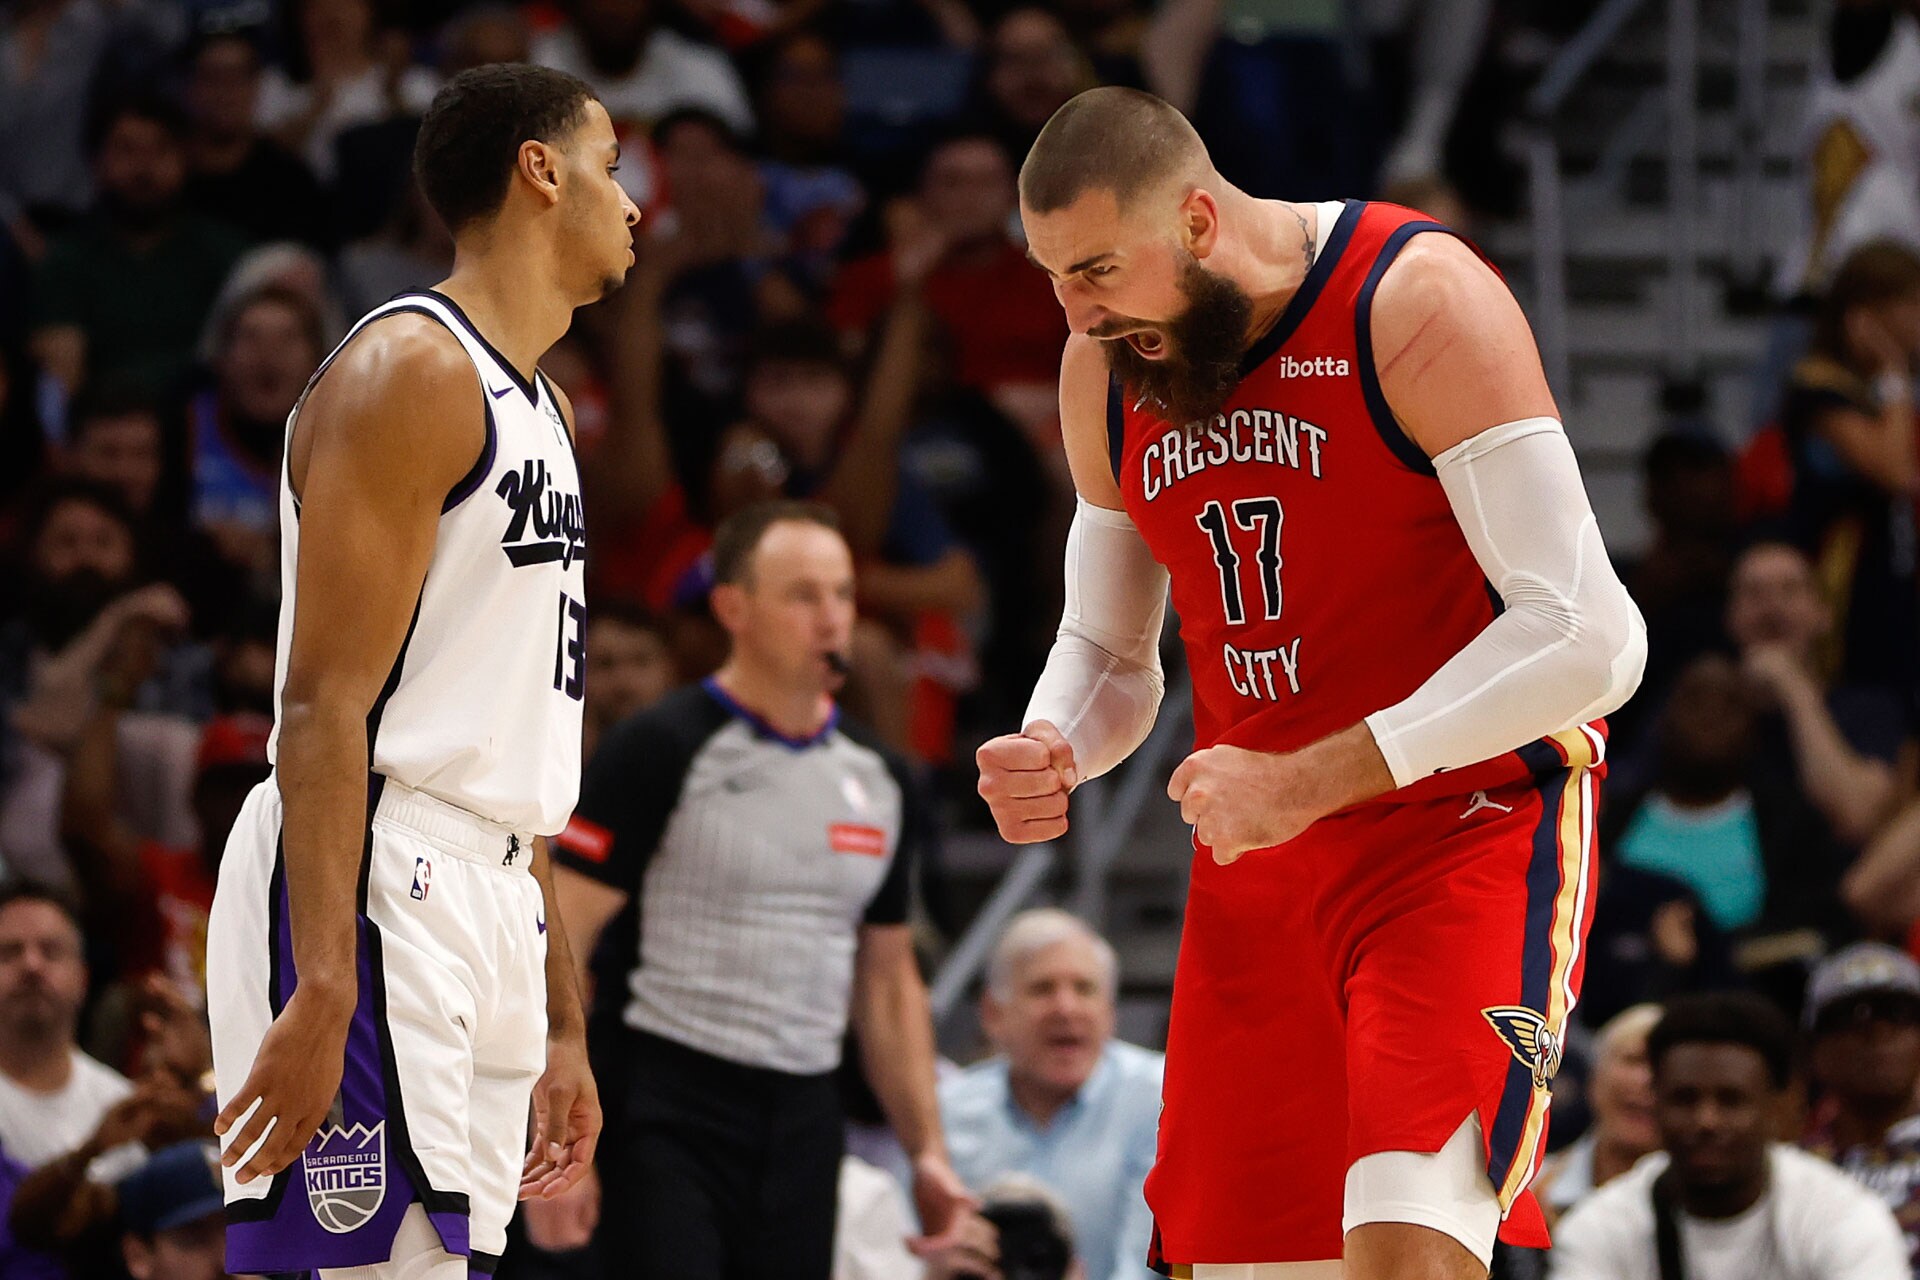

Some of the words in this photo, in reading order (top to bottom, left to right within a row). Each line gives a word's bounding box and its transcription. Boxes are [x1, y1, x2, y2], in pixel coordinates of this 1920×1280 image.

[1280, 356, 1349, 379] ibotta
[1142, 408, 1328, 502] CRESCENT
[1194, 496, 1285, 626] 17
[553, 590, 586, 702] 13
[1223, 636, 1301, 701] CITY
[307, 1153, 378, 1167] SACRAMENTO
[308, 1167, 382, 1192] KINGS
